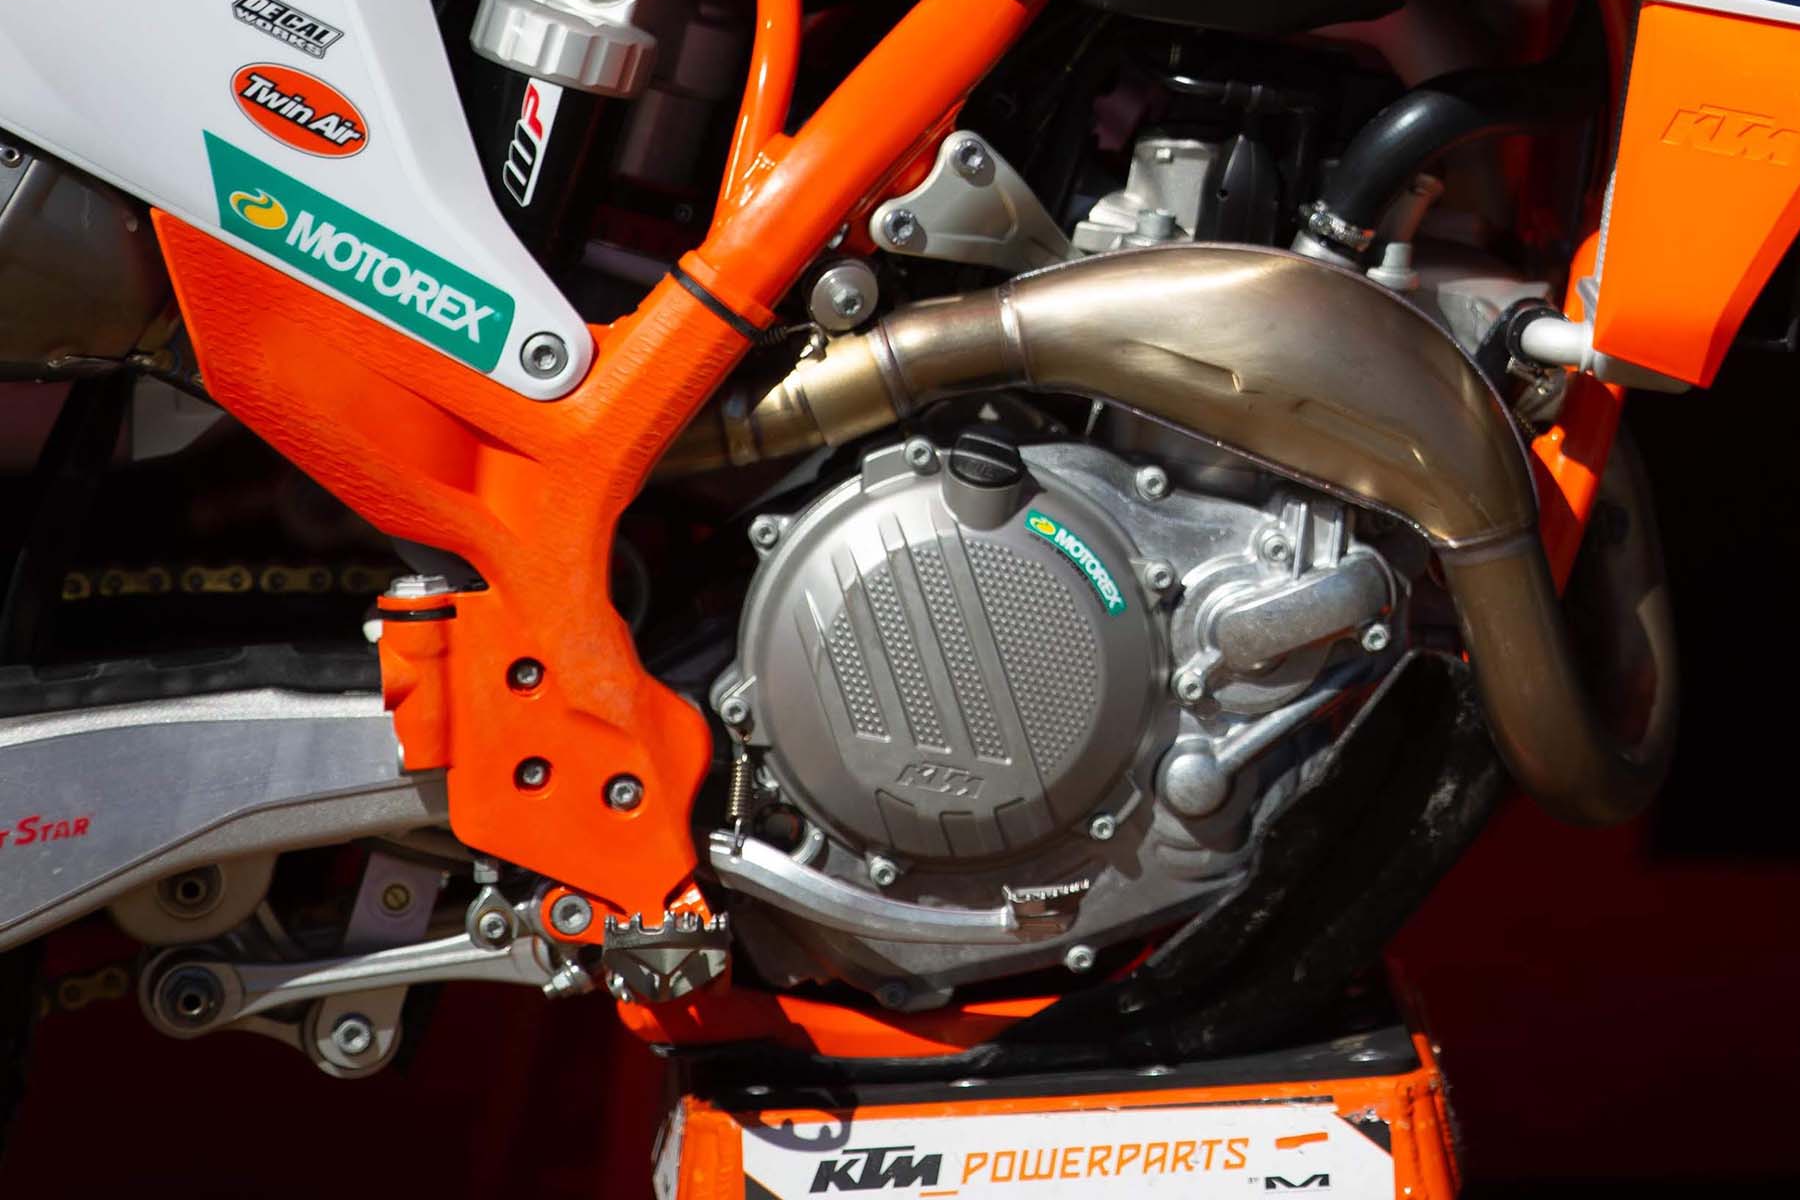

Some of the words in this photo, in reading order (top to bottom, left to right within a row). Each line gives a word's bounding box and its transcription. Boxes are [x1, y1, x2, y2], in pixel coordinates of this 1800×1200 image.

[235, 6, 323, 57] WORKS
[242, 73, 314, 126] Twin
[309, 113, 361, 145] Air
[1660, 104, 1798, 166] KTM
[286, 211, 496, 343] MOTOREX
[1054, 528, 1123, 608] MOTOREX
[894, 761, 985, 799] KTM
[809, 1145, 943, 1194] KTM
[961, 1137, 1250, 1184] POWERPARTS
